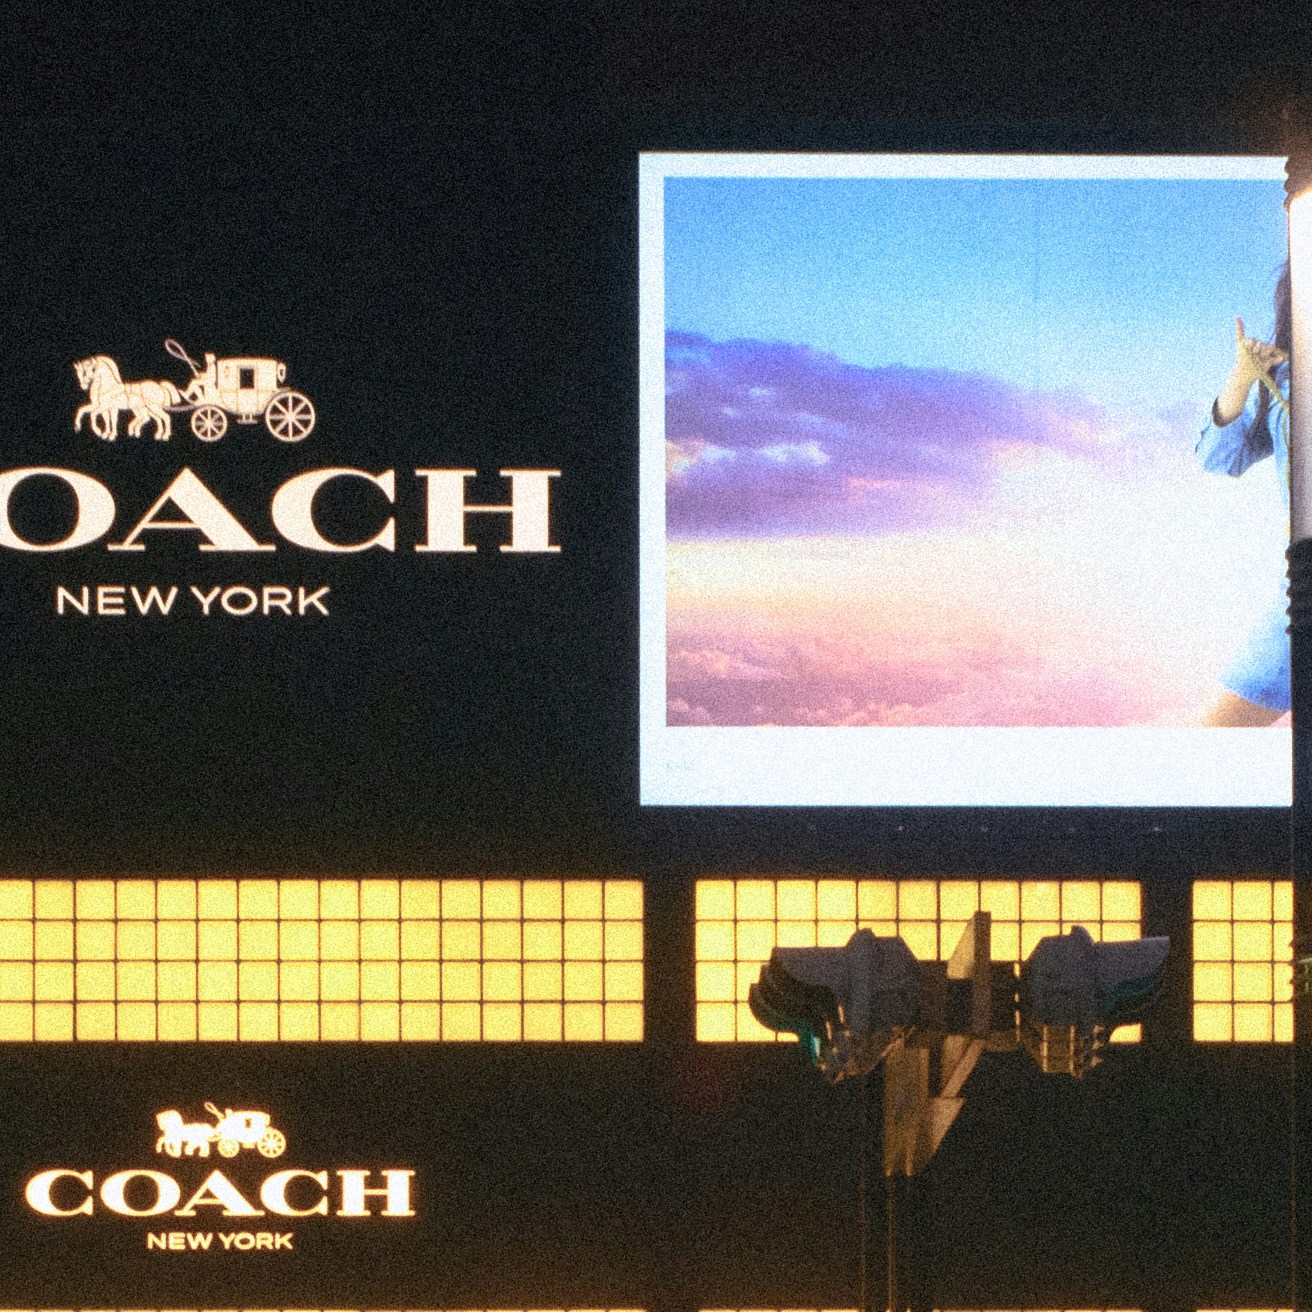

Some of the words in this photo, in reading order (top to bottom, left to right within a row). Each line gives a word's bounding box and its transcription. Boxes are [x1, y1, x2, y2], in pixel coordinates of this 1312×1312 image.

[56, 586, 178, 615] NEW
[191, 586, 330, 615] YORK
[23, 1168, 416, 1219] COACH
[147, 1231, 213, 1251] NEW
[218, 1231, 294, 1251] YORK
